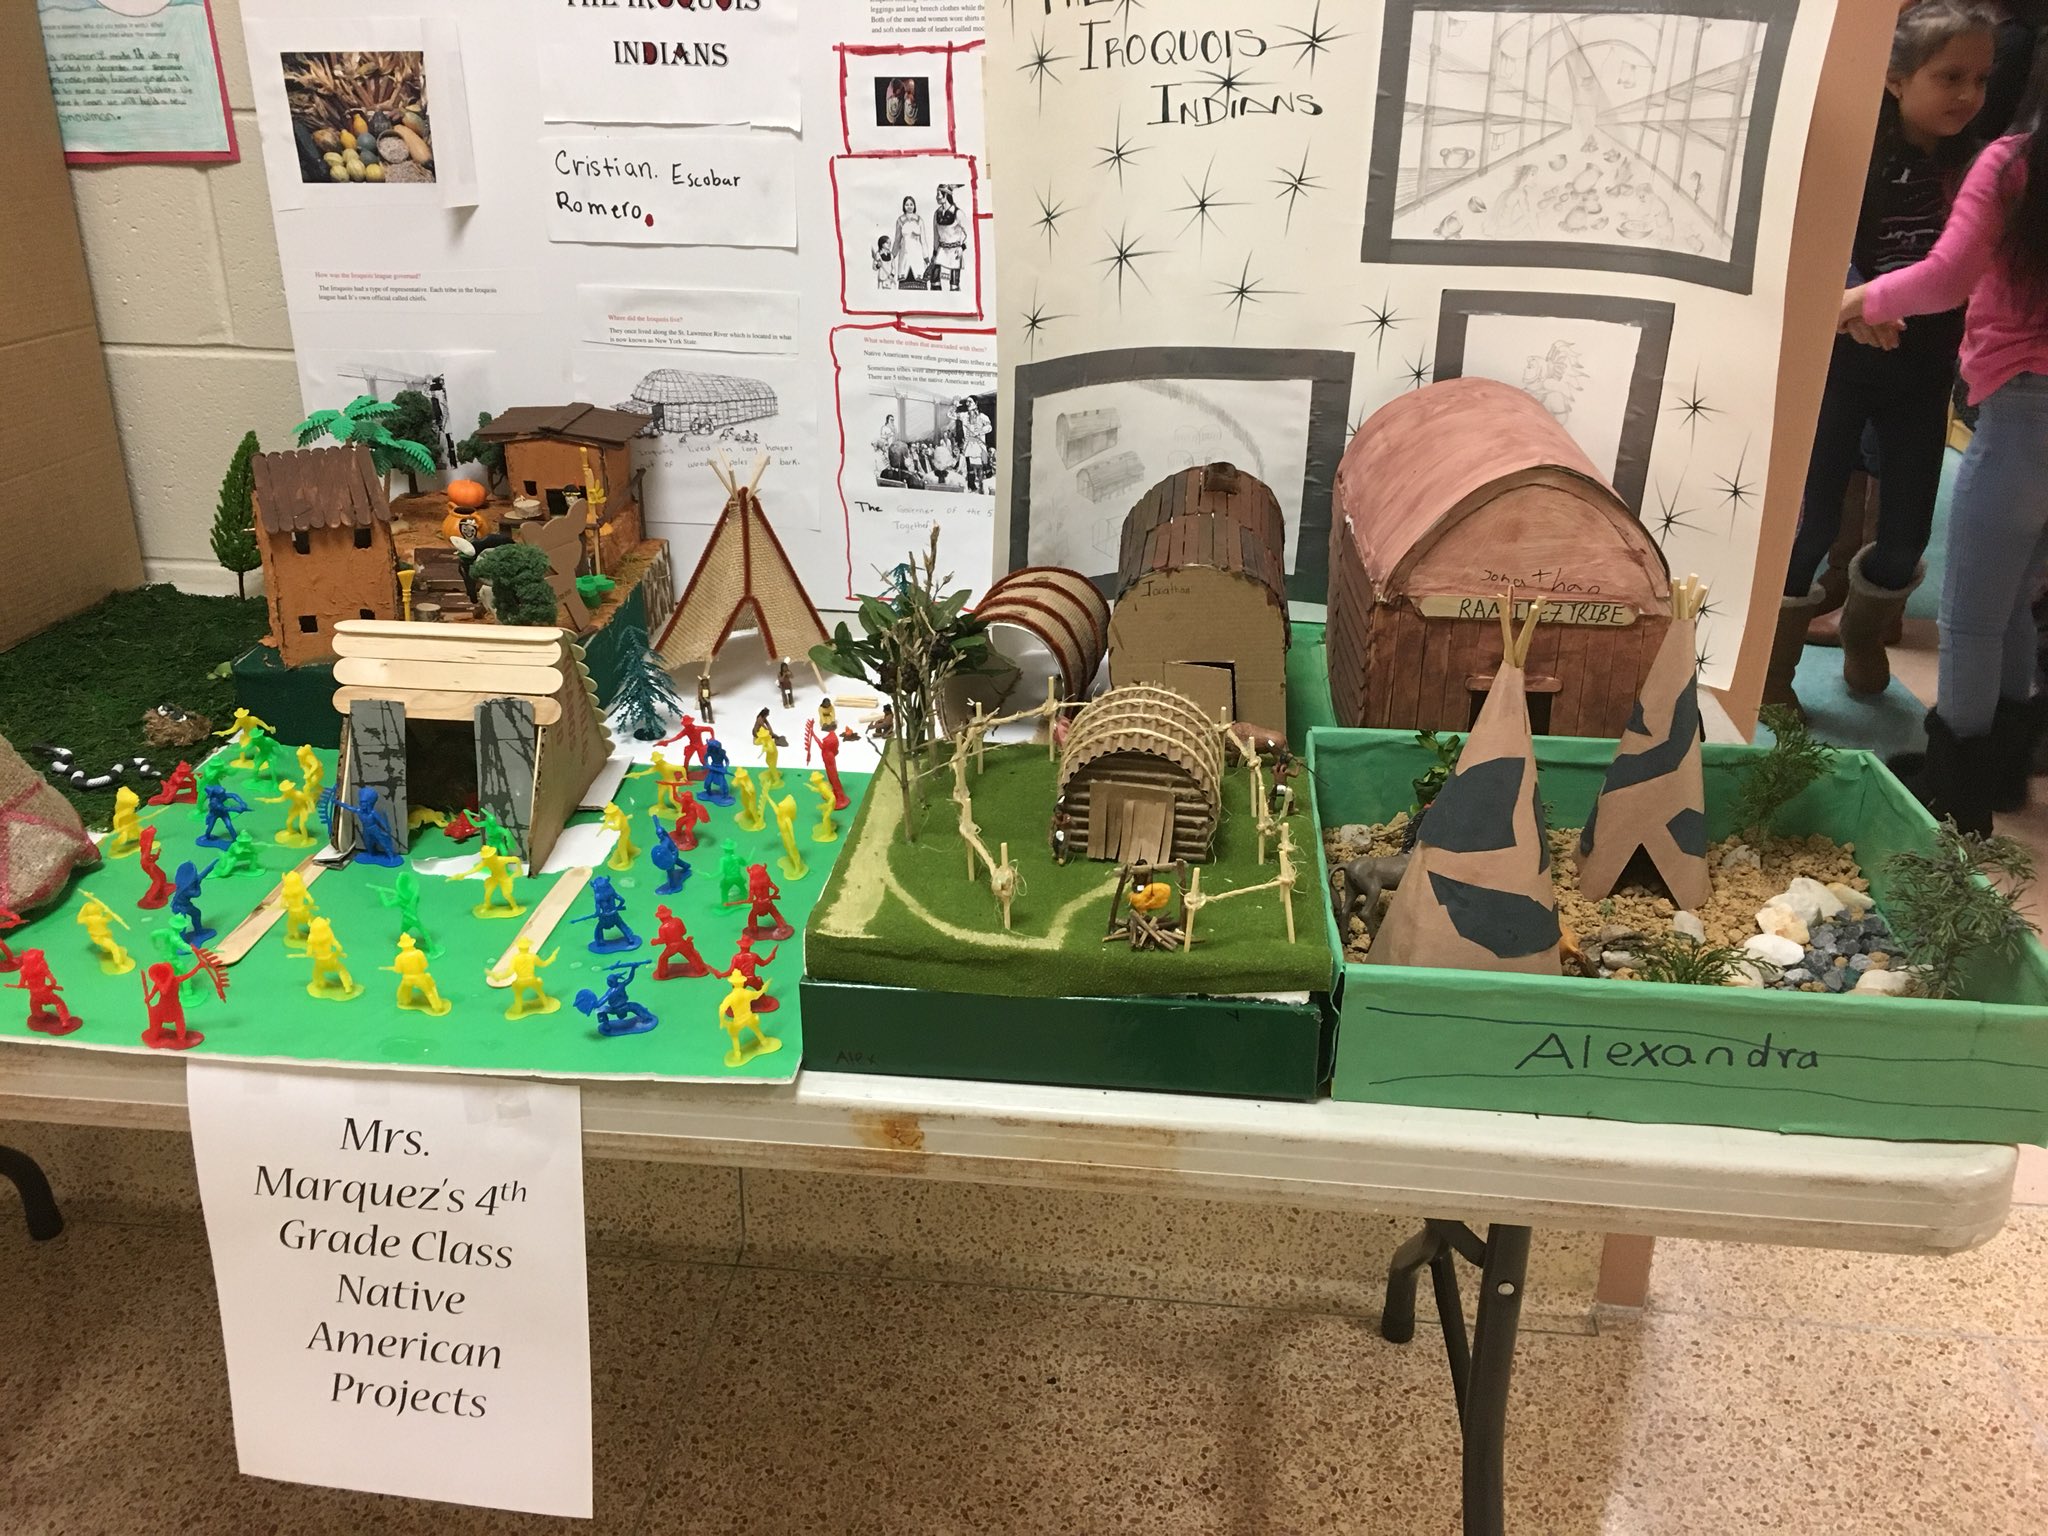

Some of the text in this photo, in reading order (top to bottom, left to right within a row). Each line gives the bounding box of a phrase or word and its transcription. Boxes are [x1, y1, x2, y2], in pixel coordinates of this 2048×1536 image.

[906, 5, 919, 13] long
[613, 41, 729, 67] INDIANS
[1079, 20, 1268, 70] IROQUOIS
[1147, 83, 1323, 127] INDIANS
[671, 163, 741, 188] Escobar
[854, 500, 883, 513] The
[1480, 568, 1601, 595] Jonathan
[1568, 601, 1626, 626] TRIBE
[1514, 1031, 1819, 1073] Alexandra
[339, 1116, 430, 1158] Mrs.
[253, 1164, 528, 1216] Marquez's 4th
[278, 1218, 513, 1270] Grade Class
[335, 1273, 467, 1316] Native
[305, 1320, 503, 1370] American
[330, 1372, 488, 1420] Projects
